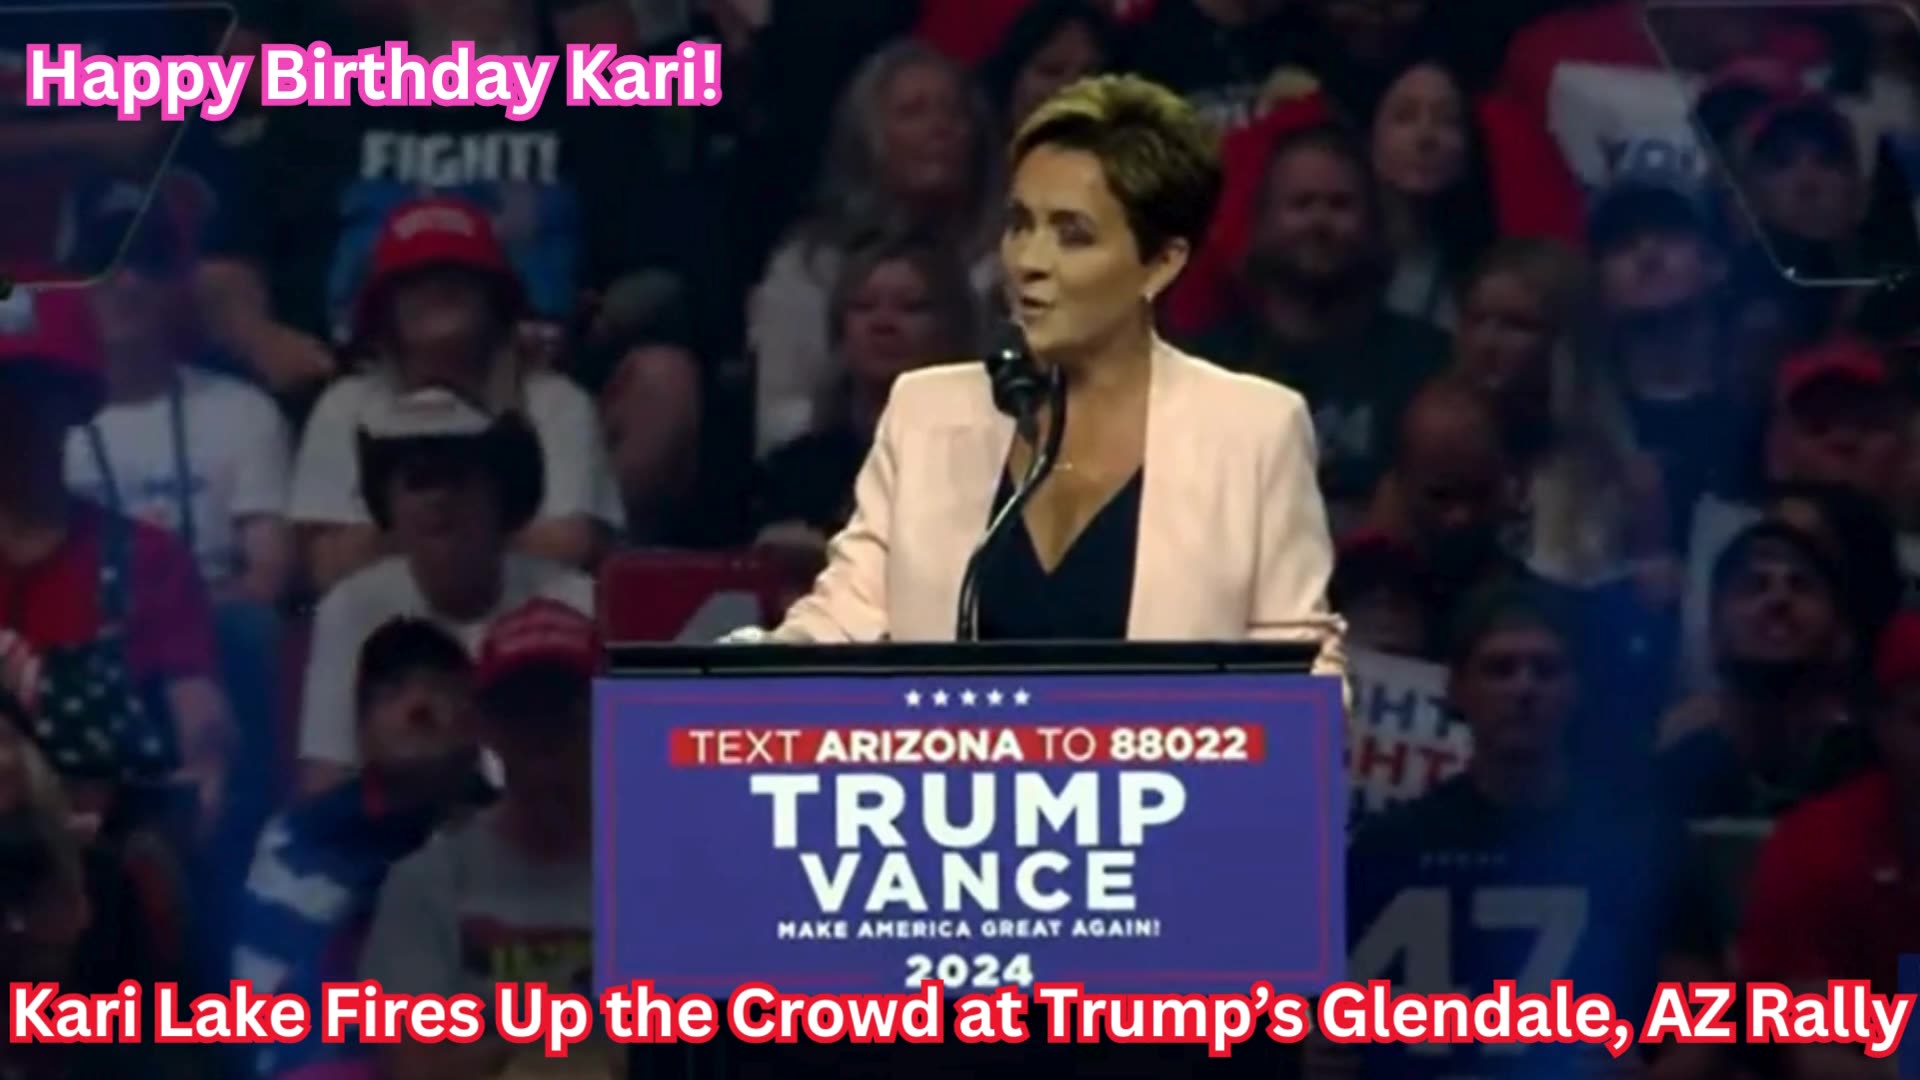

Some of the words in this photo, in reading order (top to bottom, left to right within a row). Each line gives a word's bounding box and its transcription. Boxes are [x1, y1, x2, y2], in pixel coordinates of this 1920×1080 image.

[360, 129, 561, 187] FIGHT!
[689, 729, 802, 764] TEXT
[814, 728, 1024, 763] ARIZONA
[1036, 727, 1098, 762] TO
[1109, 726, 1248, 761] 88022
[749, 771, 1187, 849] TRUMP
[799, 851, 1137, 913] VANCE
[777, 920, 848, 939] MAKE
[857, 919, 971, 939] AMERICA
[980, 918, 1062, 938] GREAT
[1071, 918, 1161, 938] AGAIN!
[904, 953, 1034, 988] 2024
[1348, 886, 1590, 1056] 47
